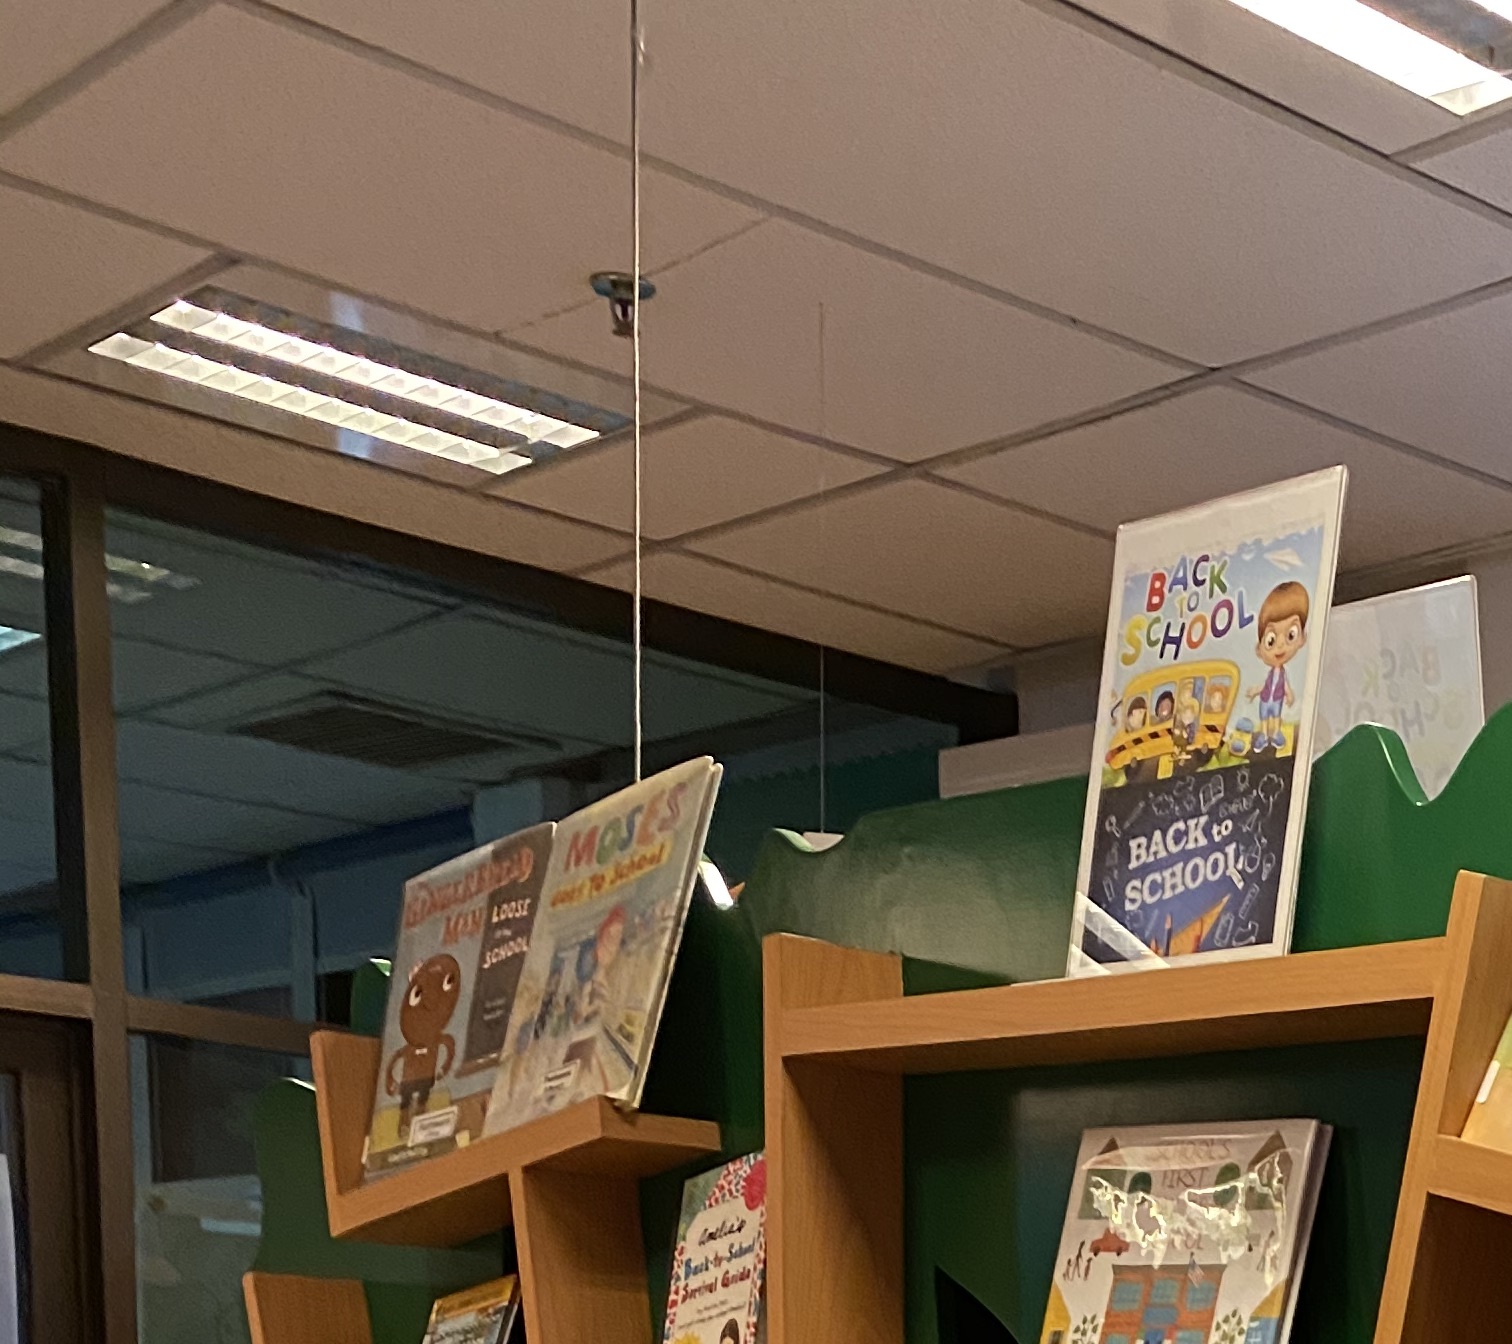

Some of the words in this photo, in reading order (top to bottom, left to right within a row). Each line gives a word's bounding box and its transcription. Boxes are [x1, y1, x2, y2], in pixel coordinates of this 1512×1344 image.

[1146, 554, 1228, 612] BACK
[1176, 591, 1200, 618] TO
[1121, 589, 1254, 666] SCHOOL
[1128, 814, 1209, 870] BACK
[1211, 819, 1233, 843] to
[1124, 841, 1243, 911] SCHOOL
[491, 898, 531, 923] LOOSE
[482, 936, 529, 969] SCHOOL
